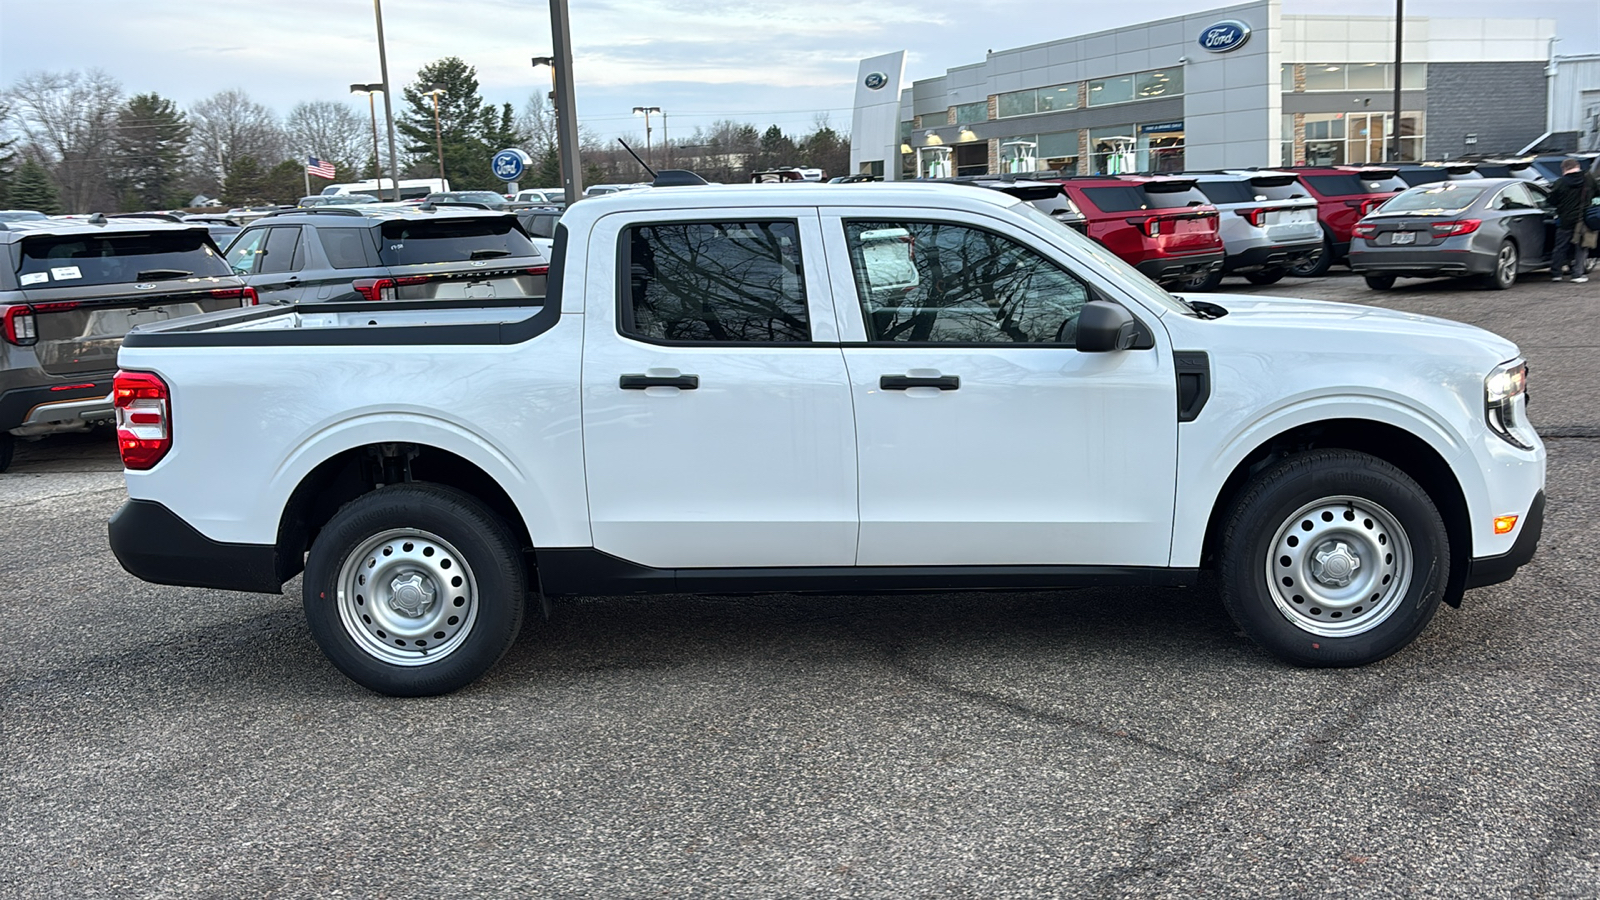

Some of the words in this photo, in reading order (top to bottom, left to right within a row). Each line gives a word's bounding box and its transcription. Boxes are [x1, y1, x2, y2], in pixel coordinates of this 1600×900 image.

[1206, 27, 1234, 47] Ford
[496, 156, 517, 175] Ford
[446, 270, 517, 278] EXPLORER
[1180, 358, 1203, 367] XL
[1325, 470, 1393, 488] Continental
